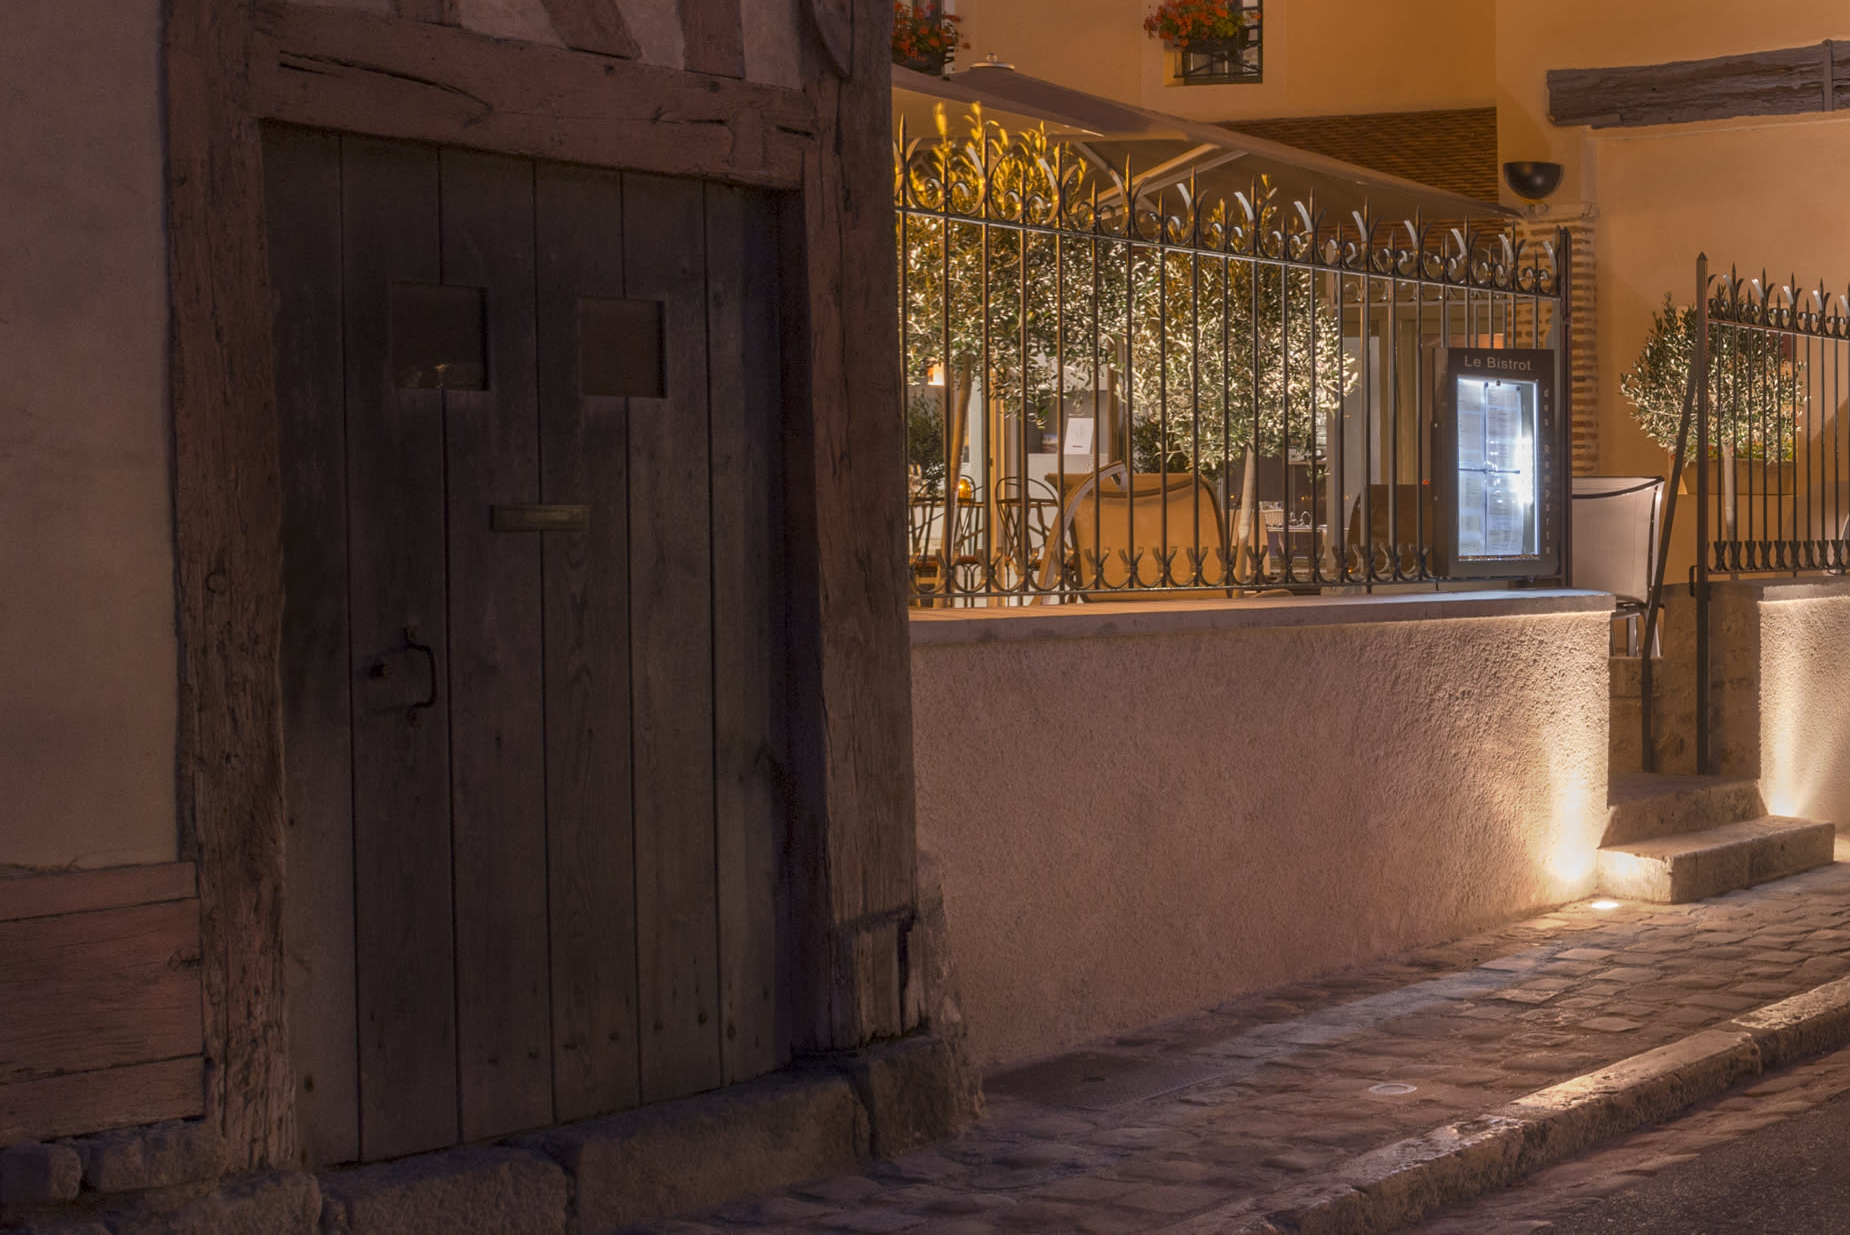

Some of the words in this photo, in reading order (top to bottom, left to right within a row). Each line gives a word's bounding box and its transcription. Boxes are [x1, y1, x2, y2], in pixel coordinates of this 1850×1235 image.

[1464, 355, 1481, 367] Le
[1487, 356, 1532, 371] Bistrot
[1543, 444, 1551, 555] Remparts
